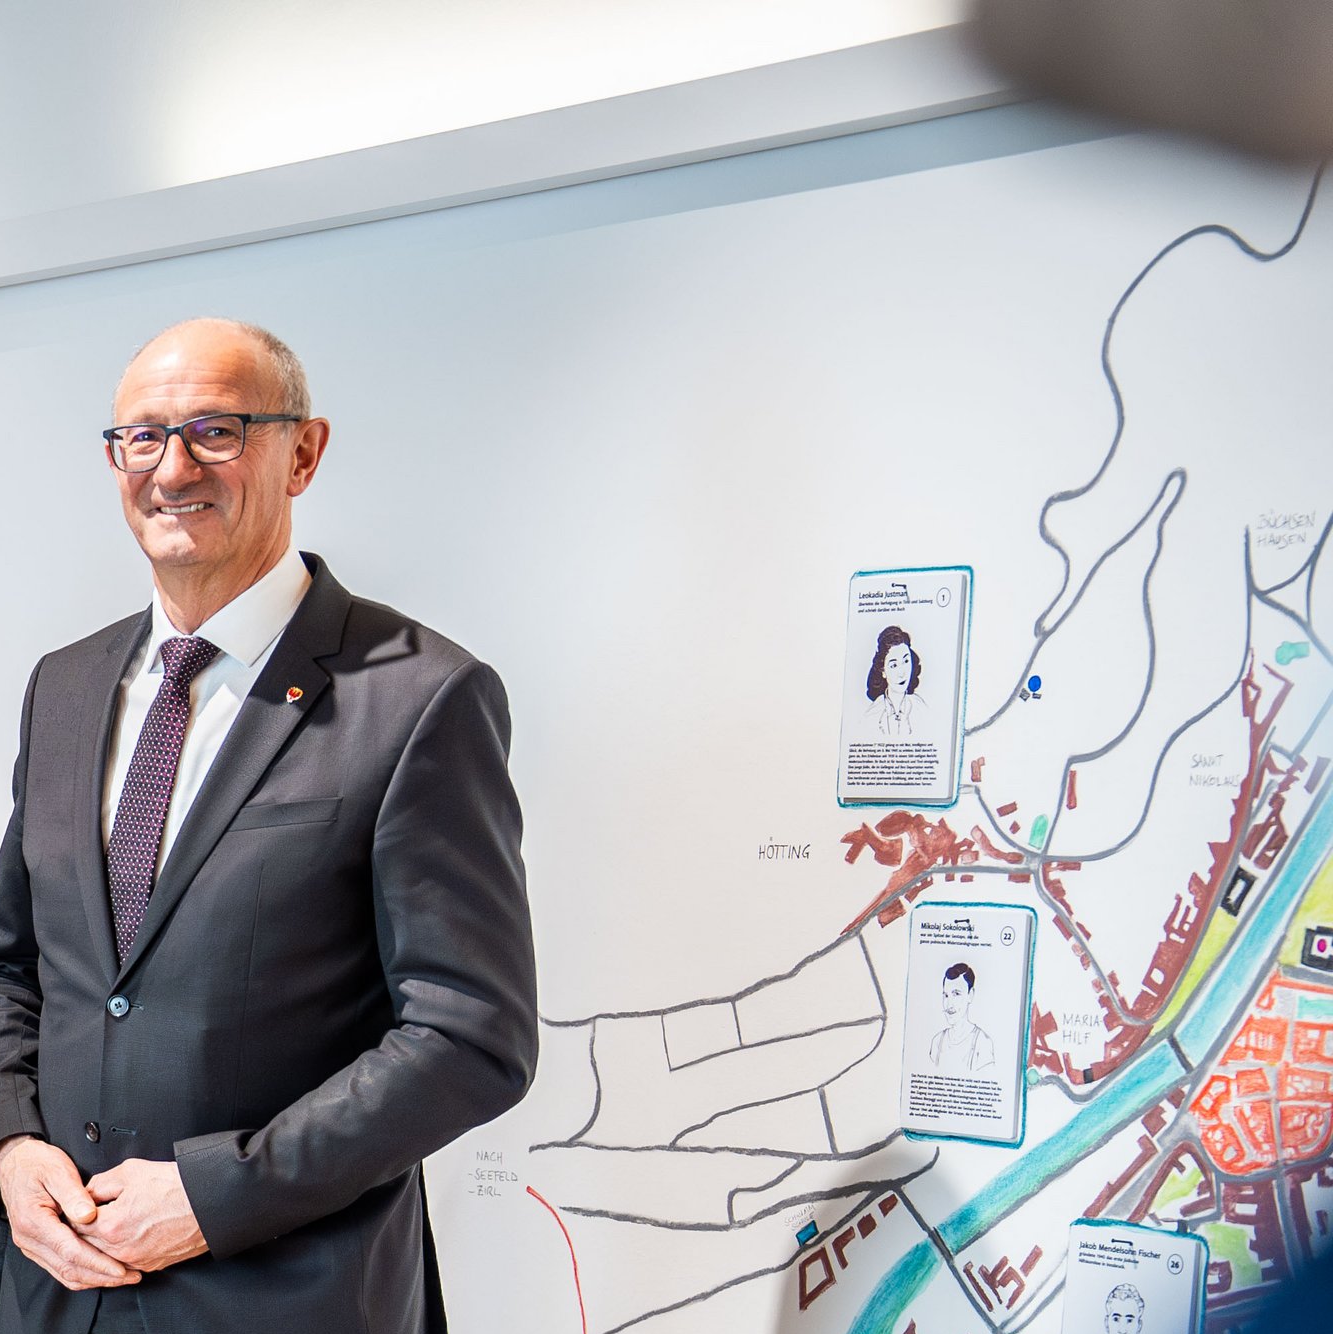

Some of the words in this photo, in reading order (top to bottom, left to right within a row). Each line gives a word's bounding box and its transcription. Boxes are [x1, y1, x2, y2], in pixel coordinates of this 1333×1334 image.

[758, 837, 810, 859] HÖTTING
[1063, 1030, 1091, 1045] HILF
[476, 1150, 503, 1165] NACH
[1079, 1241, 1097, 1250] Jakob
[1099, 1244, 1137, 1255] Mendelsohn
[1139, 1249, 1161, 1259] Fischer
